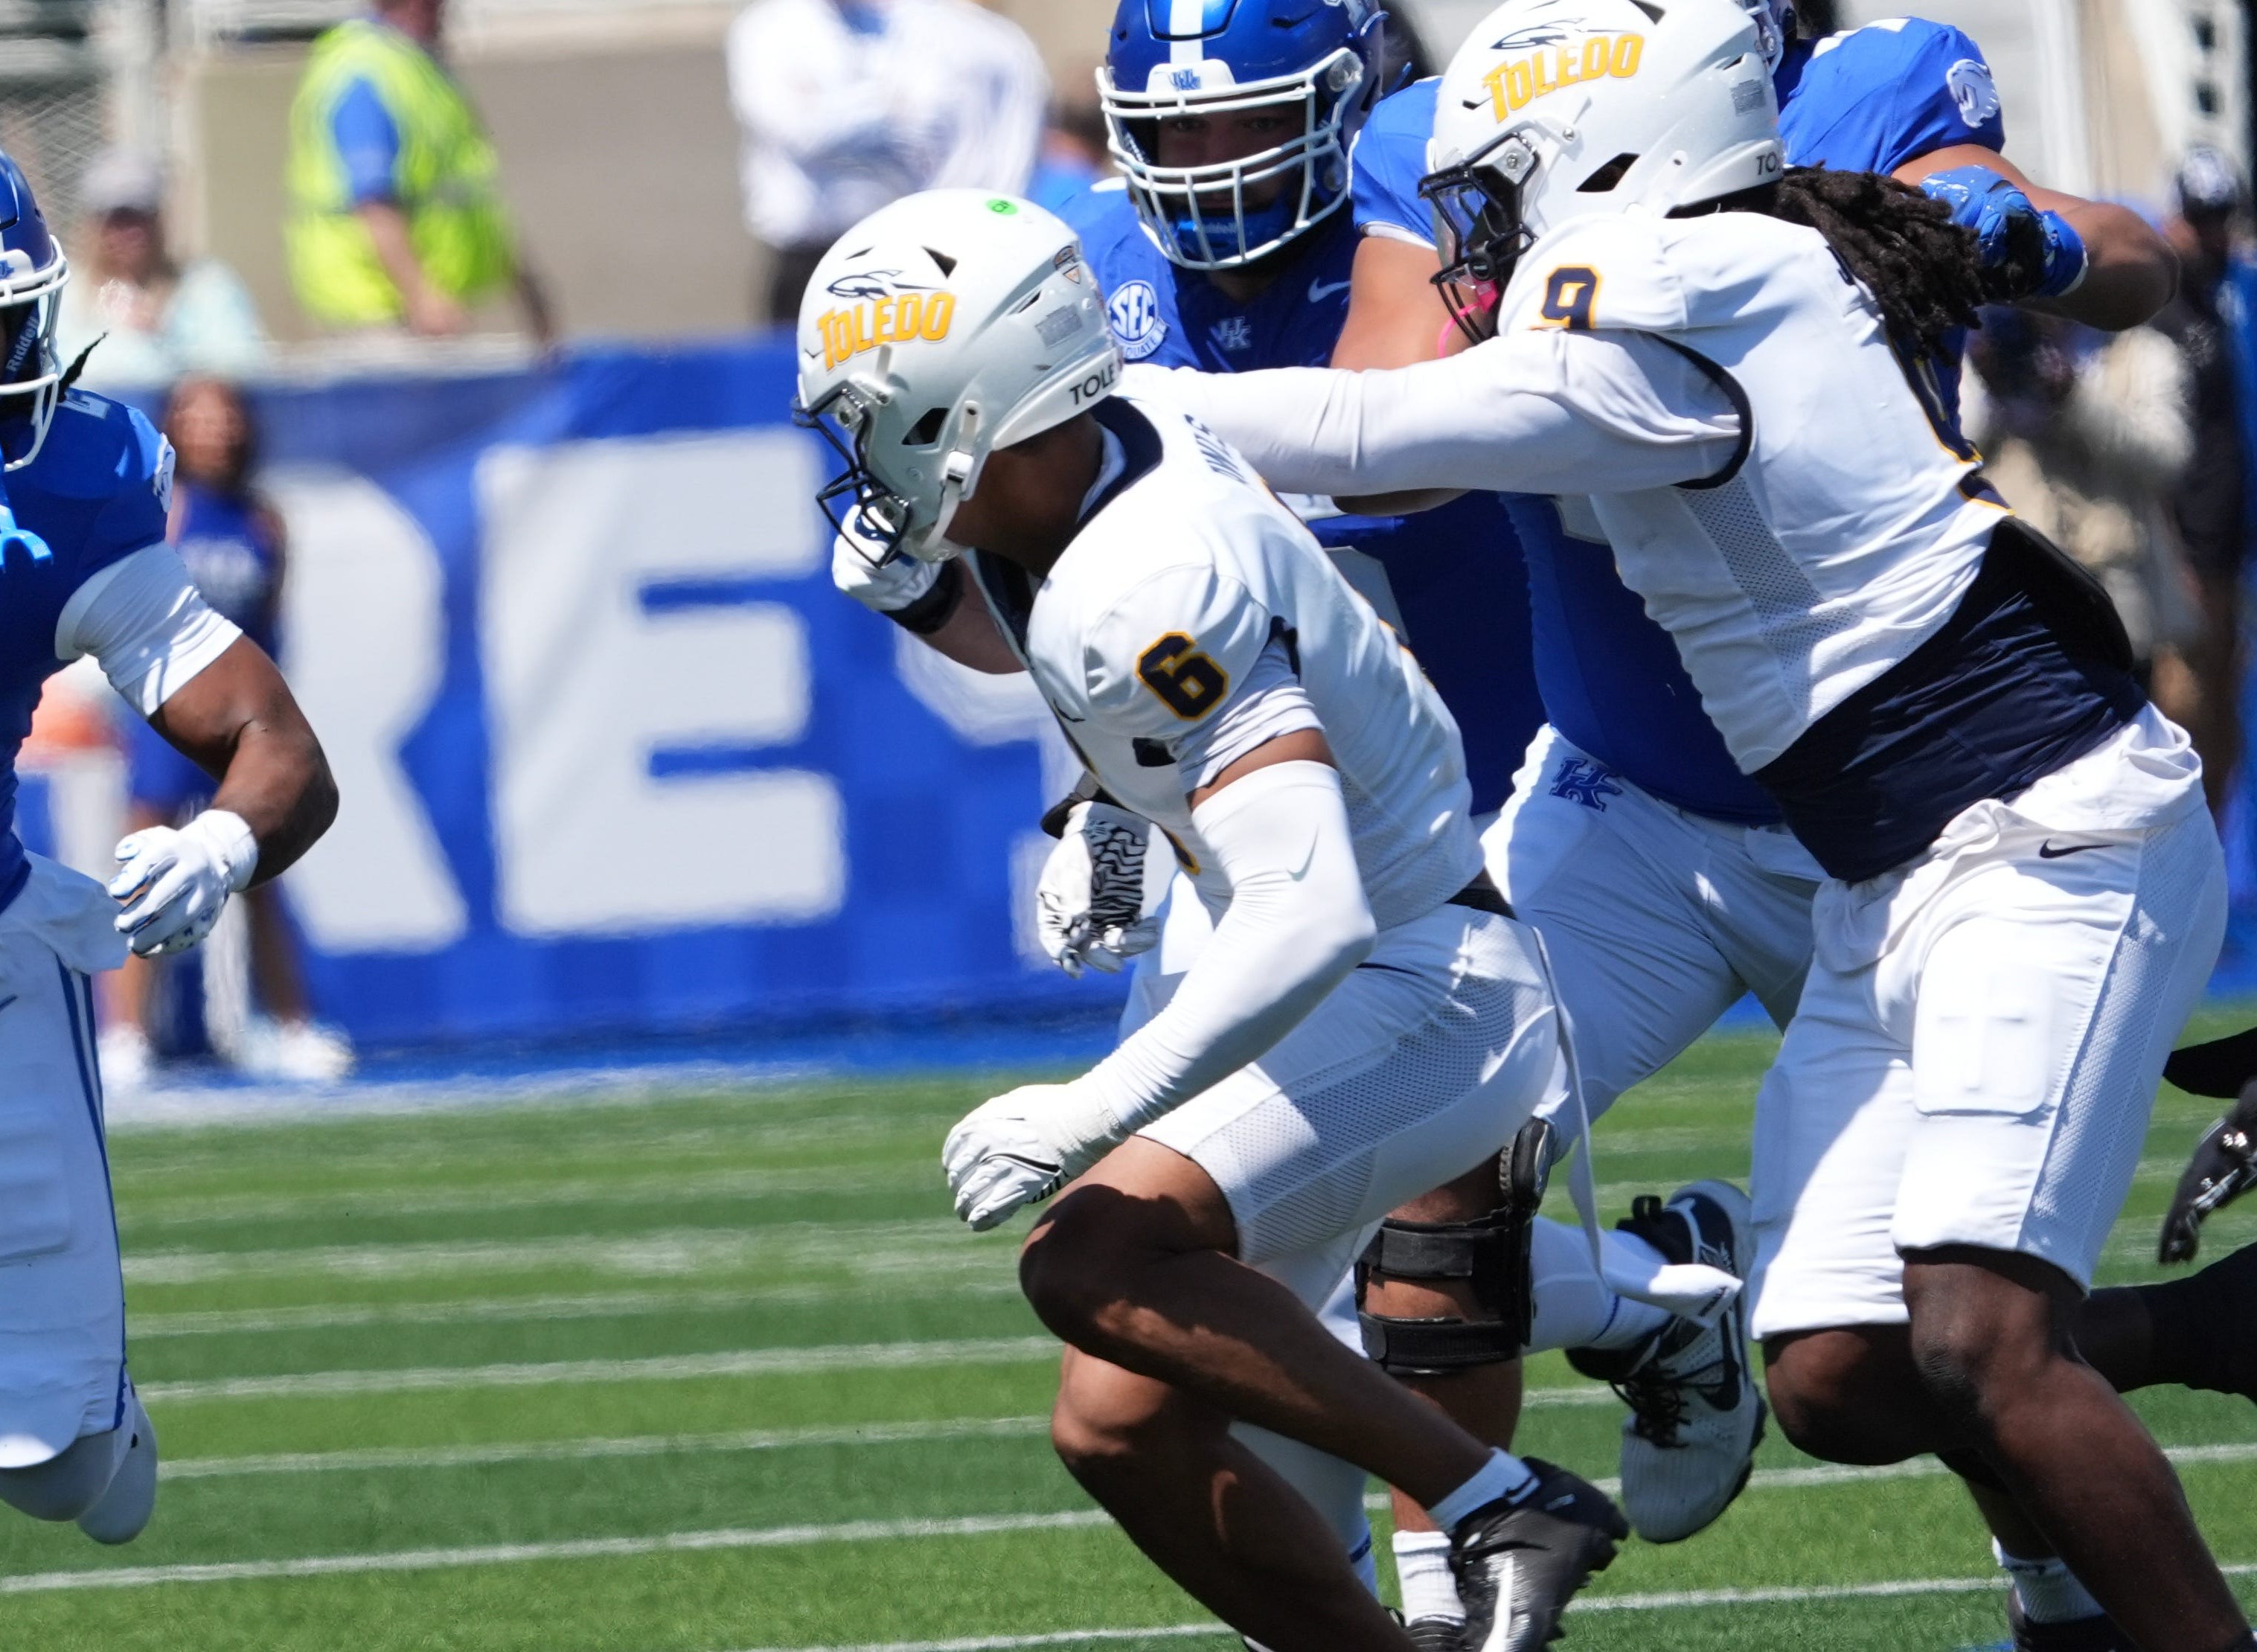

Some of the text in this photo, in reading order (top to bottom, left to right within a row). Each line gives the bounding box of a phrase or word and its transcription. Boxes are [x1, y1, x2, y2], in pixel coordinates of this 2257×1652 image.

[1481, 33, 1645, 124] TOLEDO
[1756, 151, 1782, 176] TO
[1110, 284, 1155, 339] SEC
[1539, 263, 1603, 330] 9
[5, 316, 39, 372] Riddell
[815, 290, 958, 372] TOLEDO
[1135, 631, 1230, 721] 6
